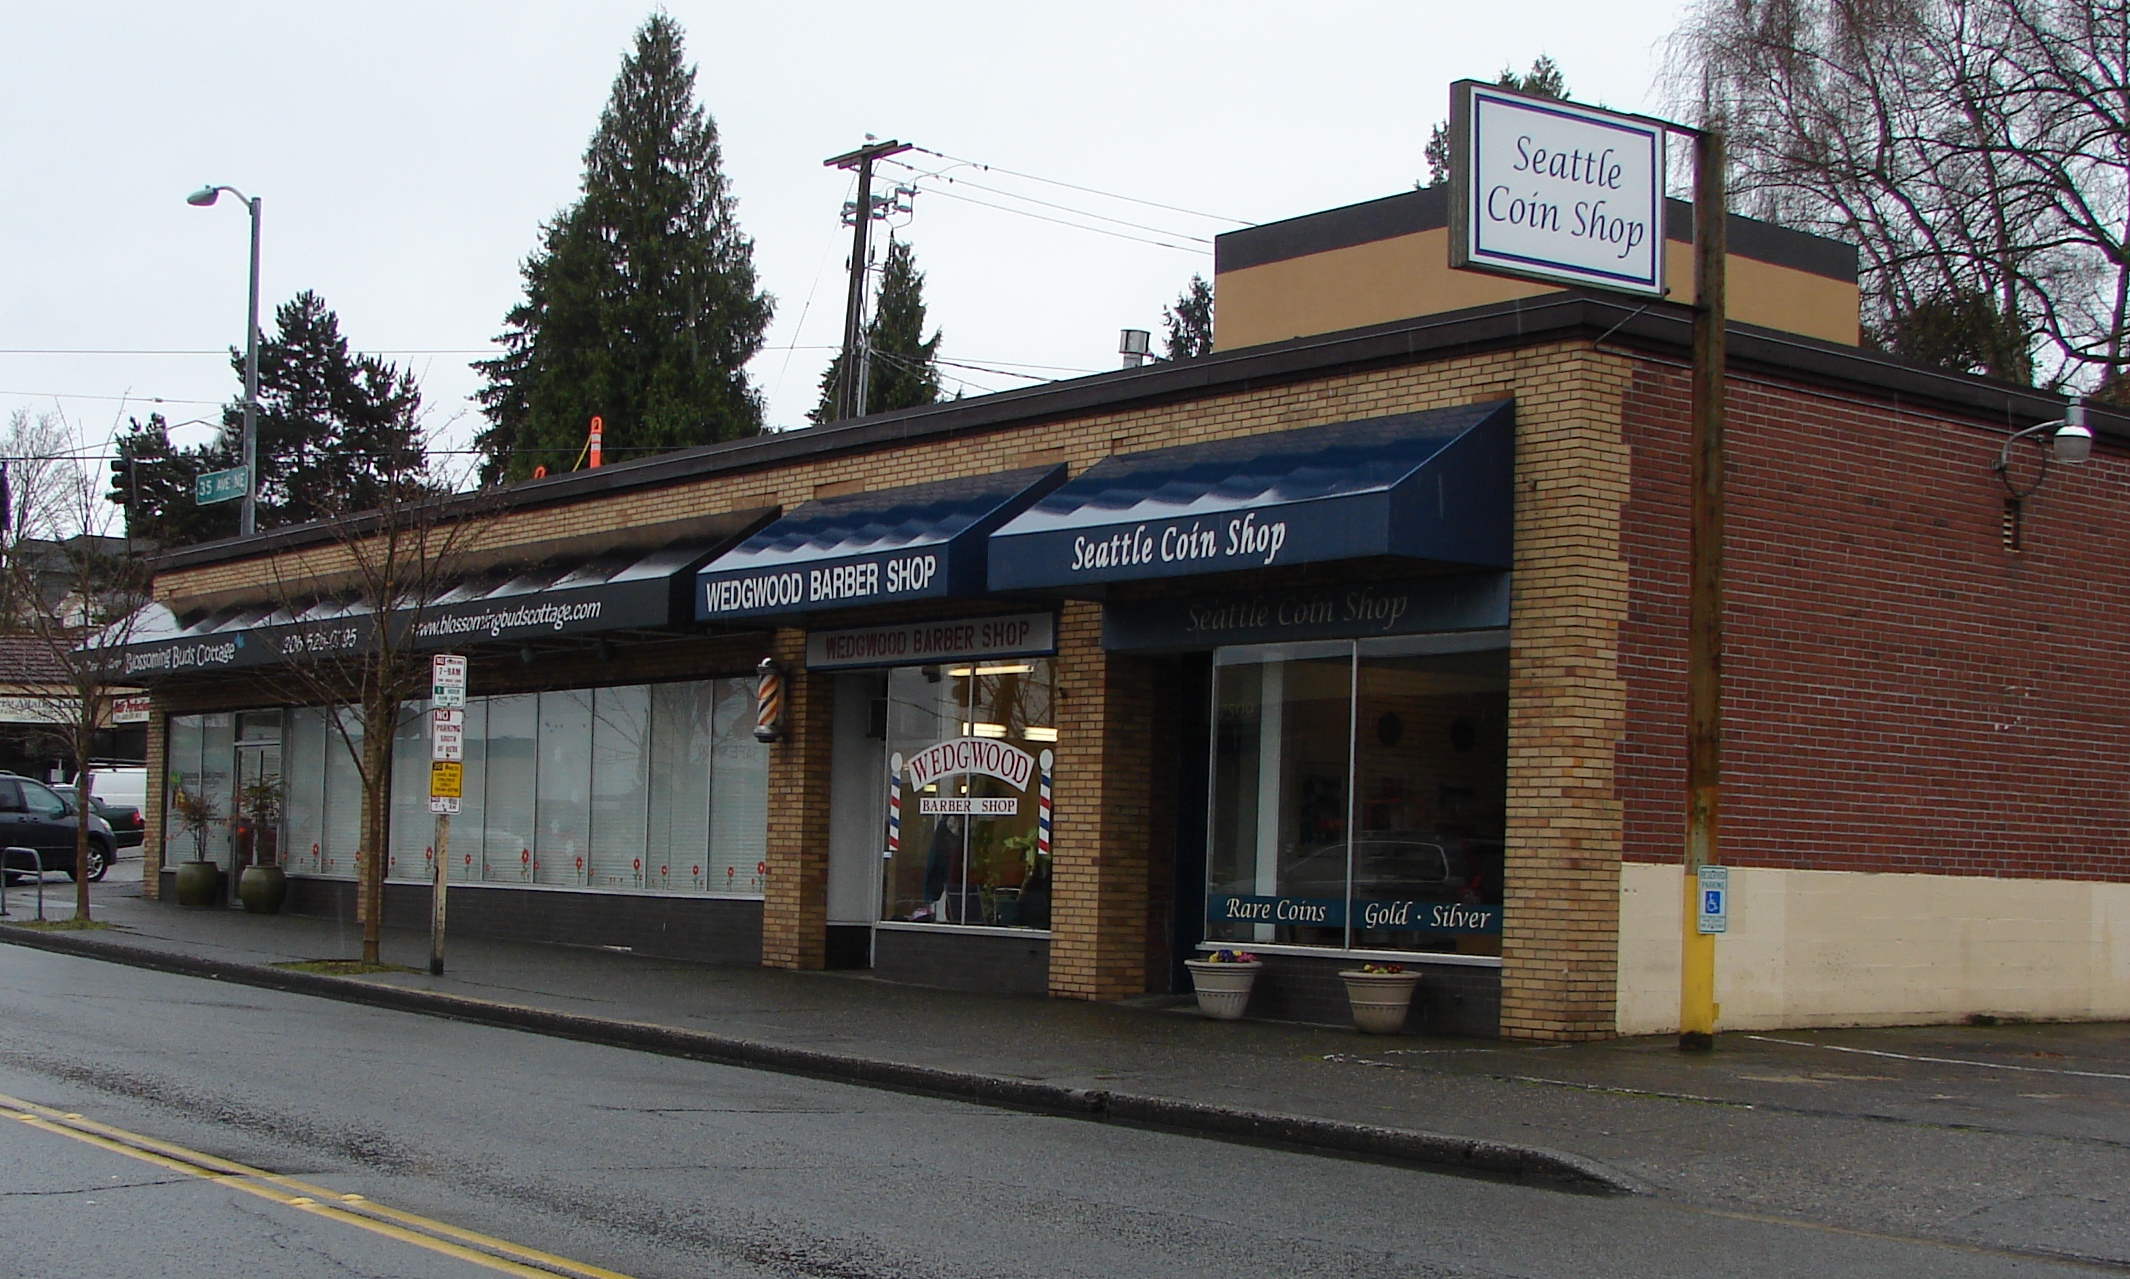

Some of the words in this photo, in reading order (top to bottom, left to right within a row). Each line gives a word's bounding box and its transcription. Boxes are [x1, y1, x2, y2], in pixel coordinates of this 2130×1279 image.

[1513, 135, 1622, 190] Seattle
[1487, 185, 1561, 232] Coin
[1571, 200, 1644, 259] Shop
[199, 480, 212, 496] 35
[216, 476, 231, 492] AVE
[234, 472, 245, 489] NE
[1072, 524, 1153, 571] Seattle
[1161, 522, 1217, 563] Coin
[1225, 512, 1286, 565] Shop
[706, 572, 803, 612] WEDGWOOD
[810, 562, 879, 602] BARBER
[886, 555, 936, 593] SHOP
[1186, 595, 1269, 632] Seattle
[1277, 594, 1334, 627] Coin
[1343, 586, 1408, 631] Shop
[125, 647, 171, 675] Blossoming
[172, 645, 195, 669] Buds
[197, 642, 236, 667] Cottage
[825, 631, 907, 660] WEDGWOOD
[913, 625, 974, 654] BARBER
[982, 621, 1030, 648] SHOP
[436, 710, 449, 720] NO
[437, 724, 461, 732] PARKING
[911, 741, 1028, 784] WEDGWOOD
[922, 799, 971, 812] BARBER
[981, 800, 1015, 812] SHOP
[1226, 898, 1270, 919] Rare
[1276, 899, 1326, 922] Coins
[1365, 901, 1413, 929] Gold
[1430, 904, 1492, 929] Silver
